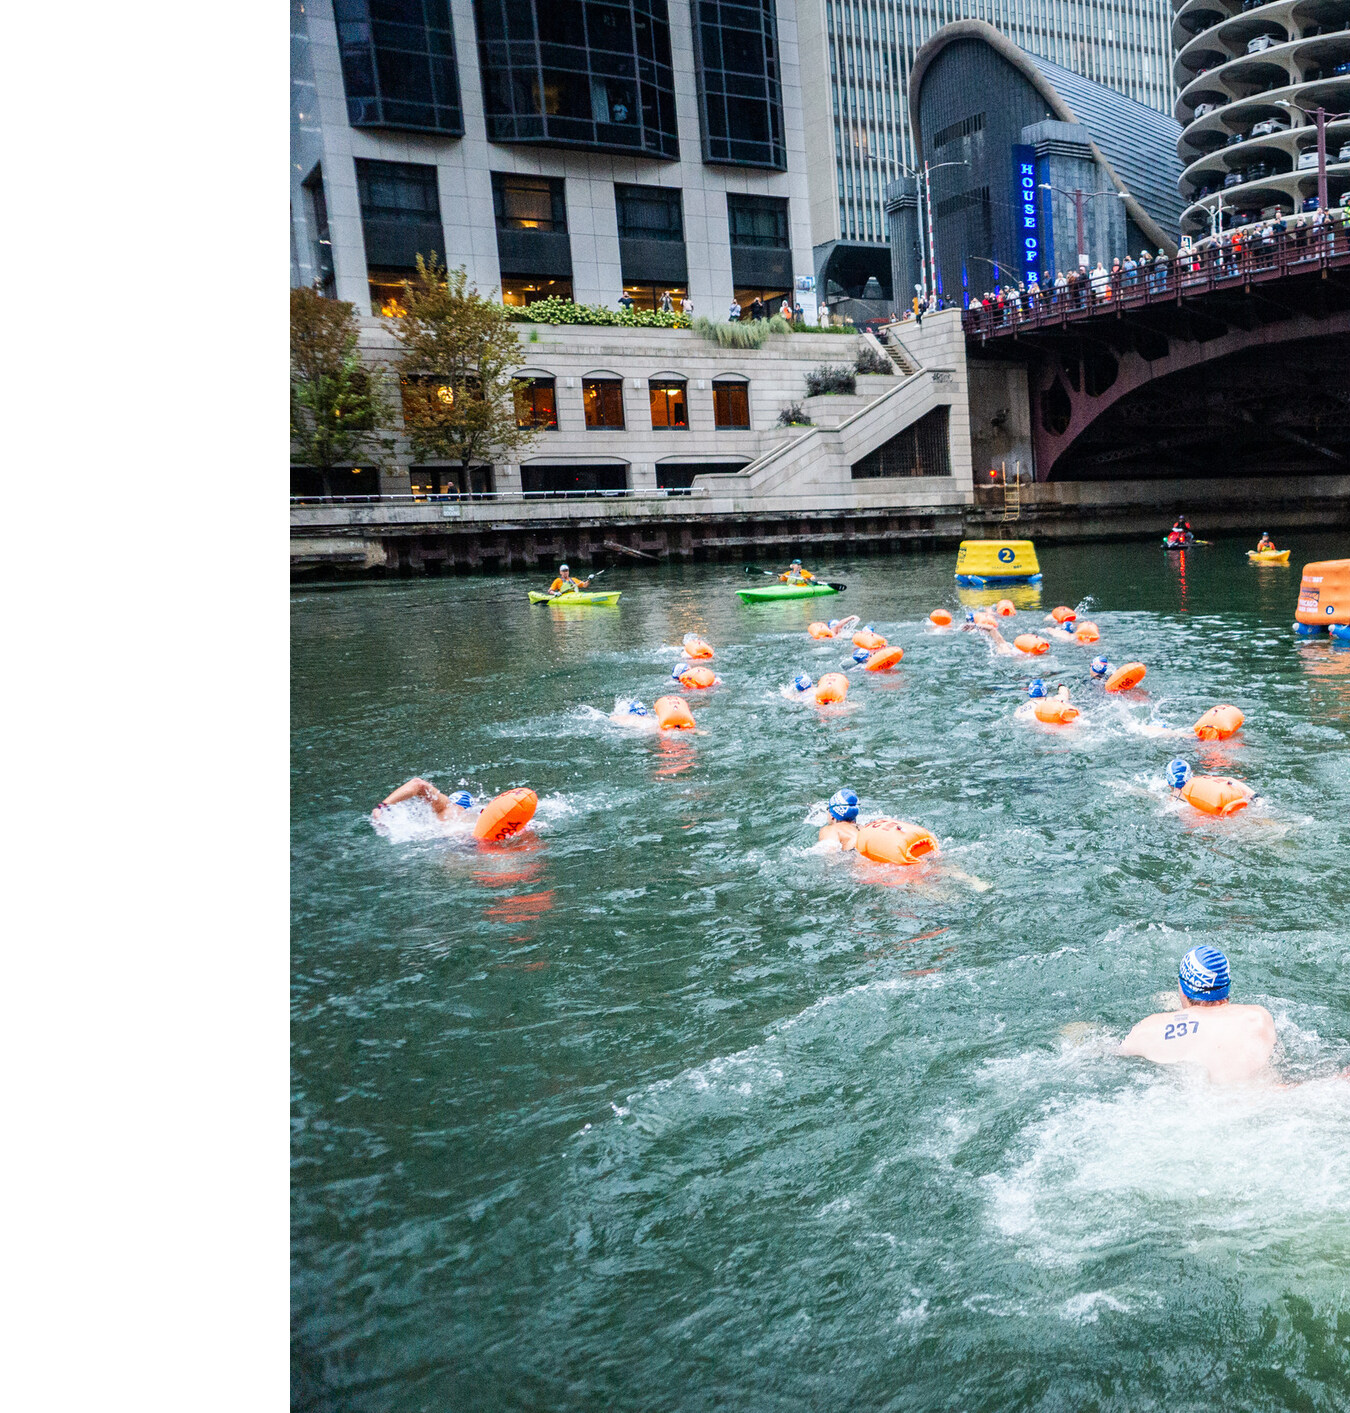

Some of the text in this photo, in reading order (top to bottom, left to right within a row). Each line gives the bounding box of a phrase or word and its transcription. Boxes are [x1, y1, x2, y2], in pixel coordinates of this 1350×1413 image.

[1020, 163, 1036, 228] HOUSE
[1025, 237, 1037, 262] OF
[1002, 549, 1012, 561] 2
[1164, 1020, 1200, 1040] 237
